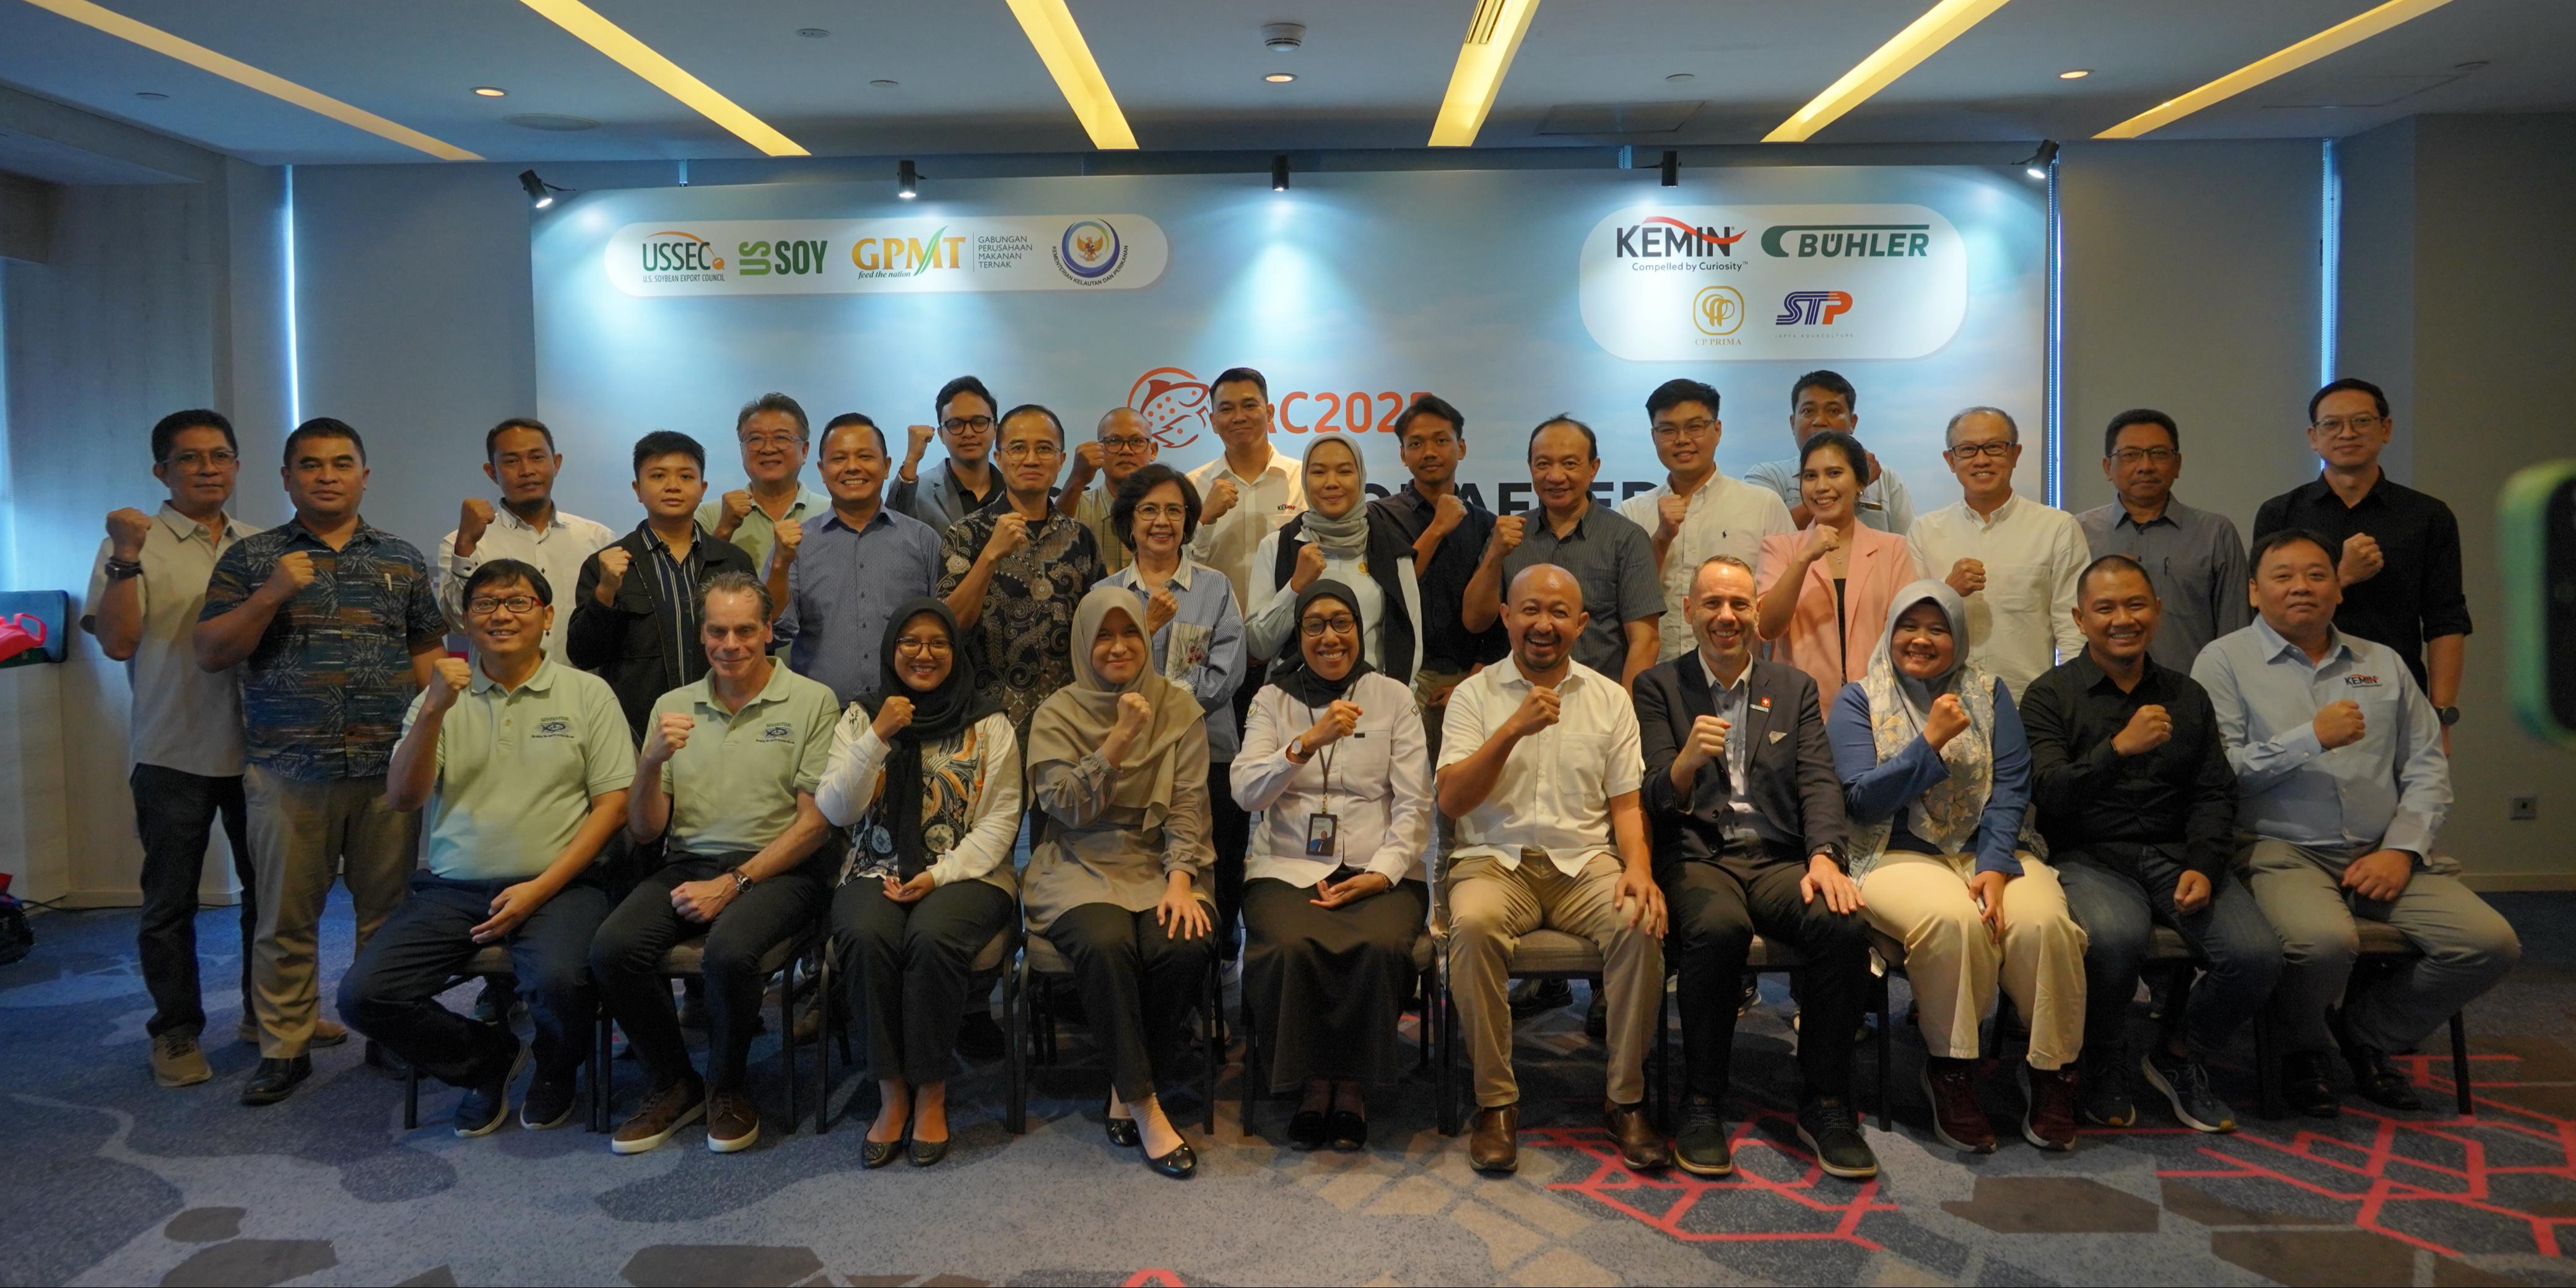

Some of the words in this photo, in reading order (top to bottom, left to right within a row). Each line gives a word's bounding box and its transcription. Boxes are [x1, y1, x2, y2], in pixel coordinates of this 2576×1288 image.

[642, 242, 710, 271] USSEC
[739, 241, 772, 276] US
[775, 240, 827, 274] SOY
[851, 237, 966, 271] GPMT
[1798, 233, 1929, 257] BÜHLER
[702, 274, 724, 282] COUNCIL
[858, 271, 874, 279] feed
[1051, 246, 1073, 281] KEMENTERIAN
[1102, 274, 1114, 283] DAN
[1113, 245, 1128, 276] PERIKANAN
[1632, 262, 1683, 272] Compelled
[1686, 262, 1697, 272] by
[1775, 291, 1853, 325] STP
